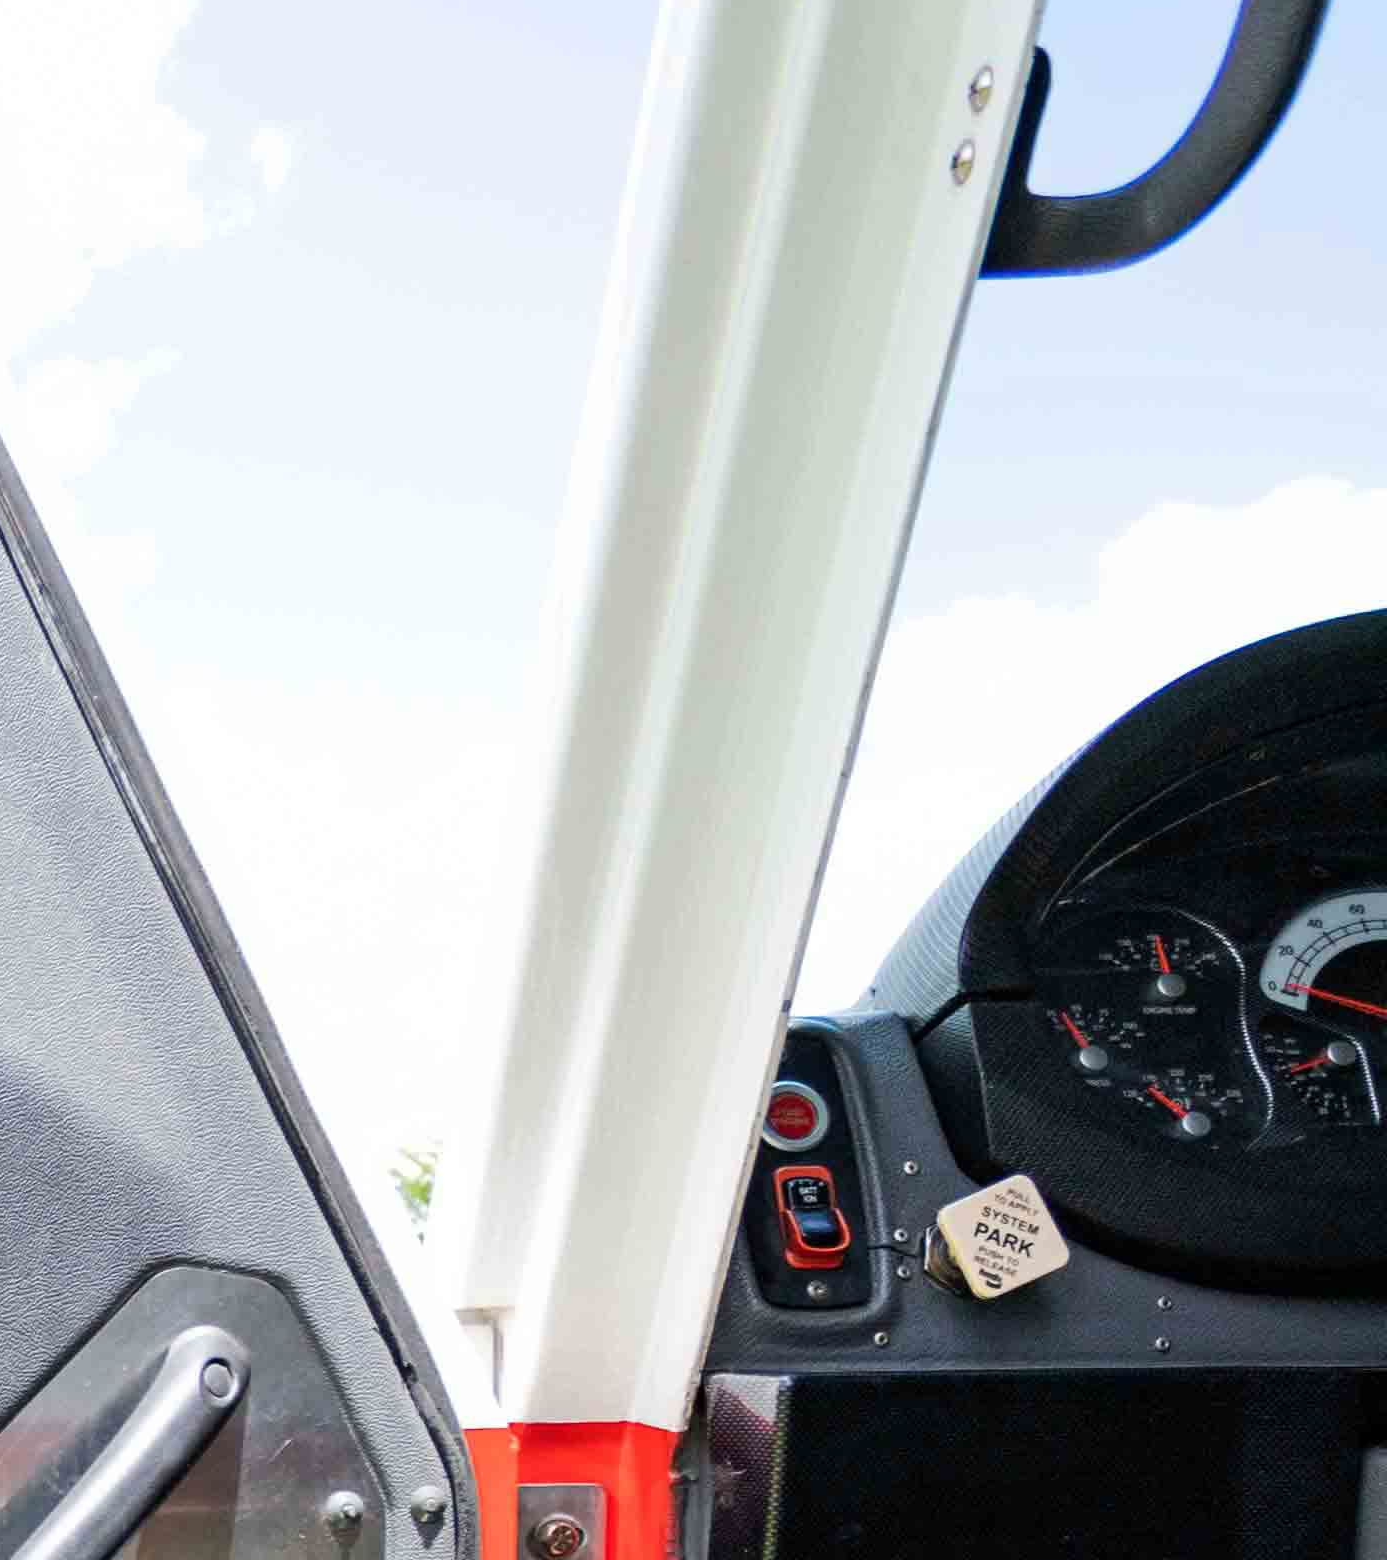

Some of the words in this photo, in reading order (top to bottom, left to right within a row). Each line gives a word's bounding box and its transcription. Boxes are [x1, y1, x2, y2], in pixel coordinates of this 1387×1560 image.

[1349, 904, 1365, 915] 60
[1307, 919, 1323, 929] 40
[1279, 945, 1294, 956] 20
[1268, 981, 1277, 991] 0
[981, 1206, 1039, 1235] SYSTEM
[973, 1222, 1035, 1258] PARK
[978, 1246, 1004, 1260] PUSH
